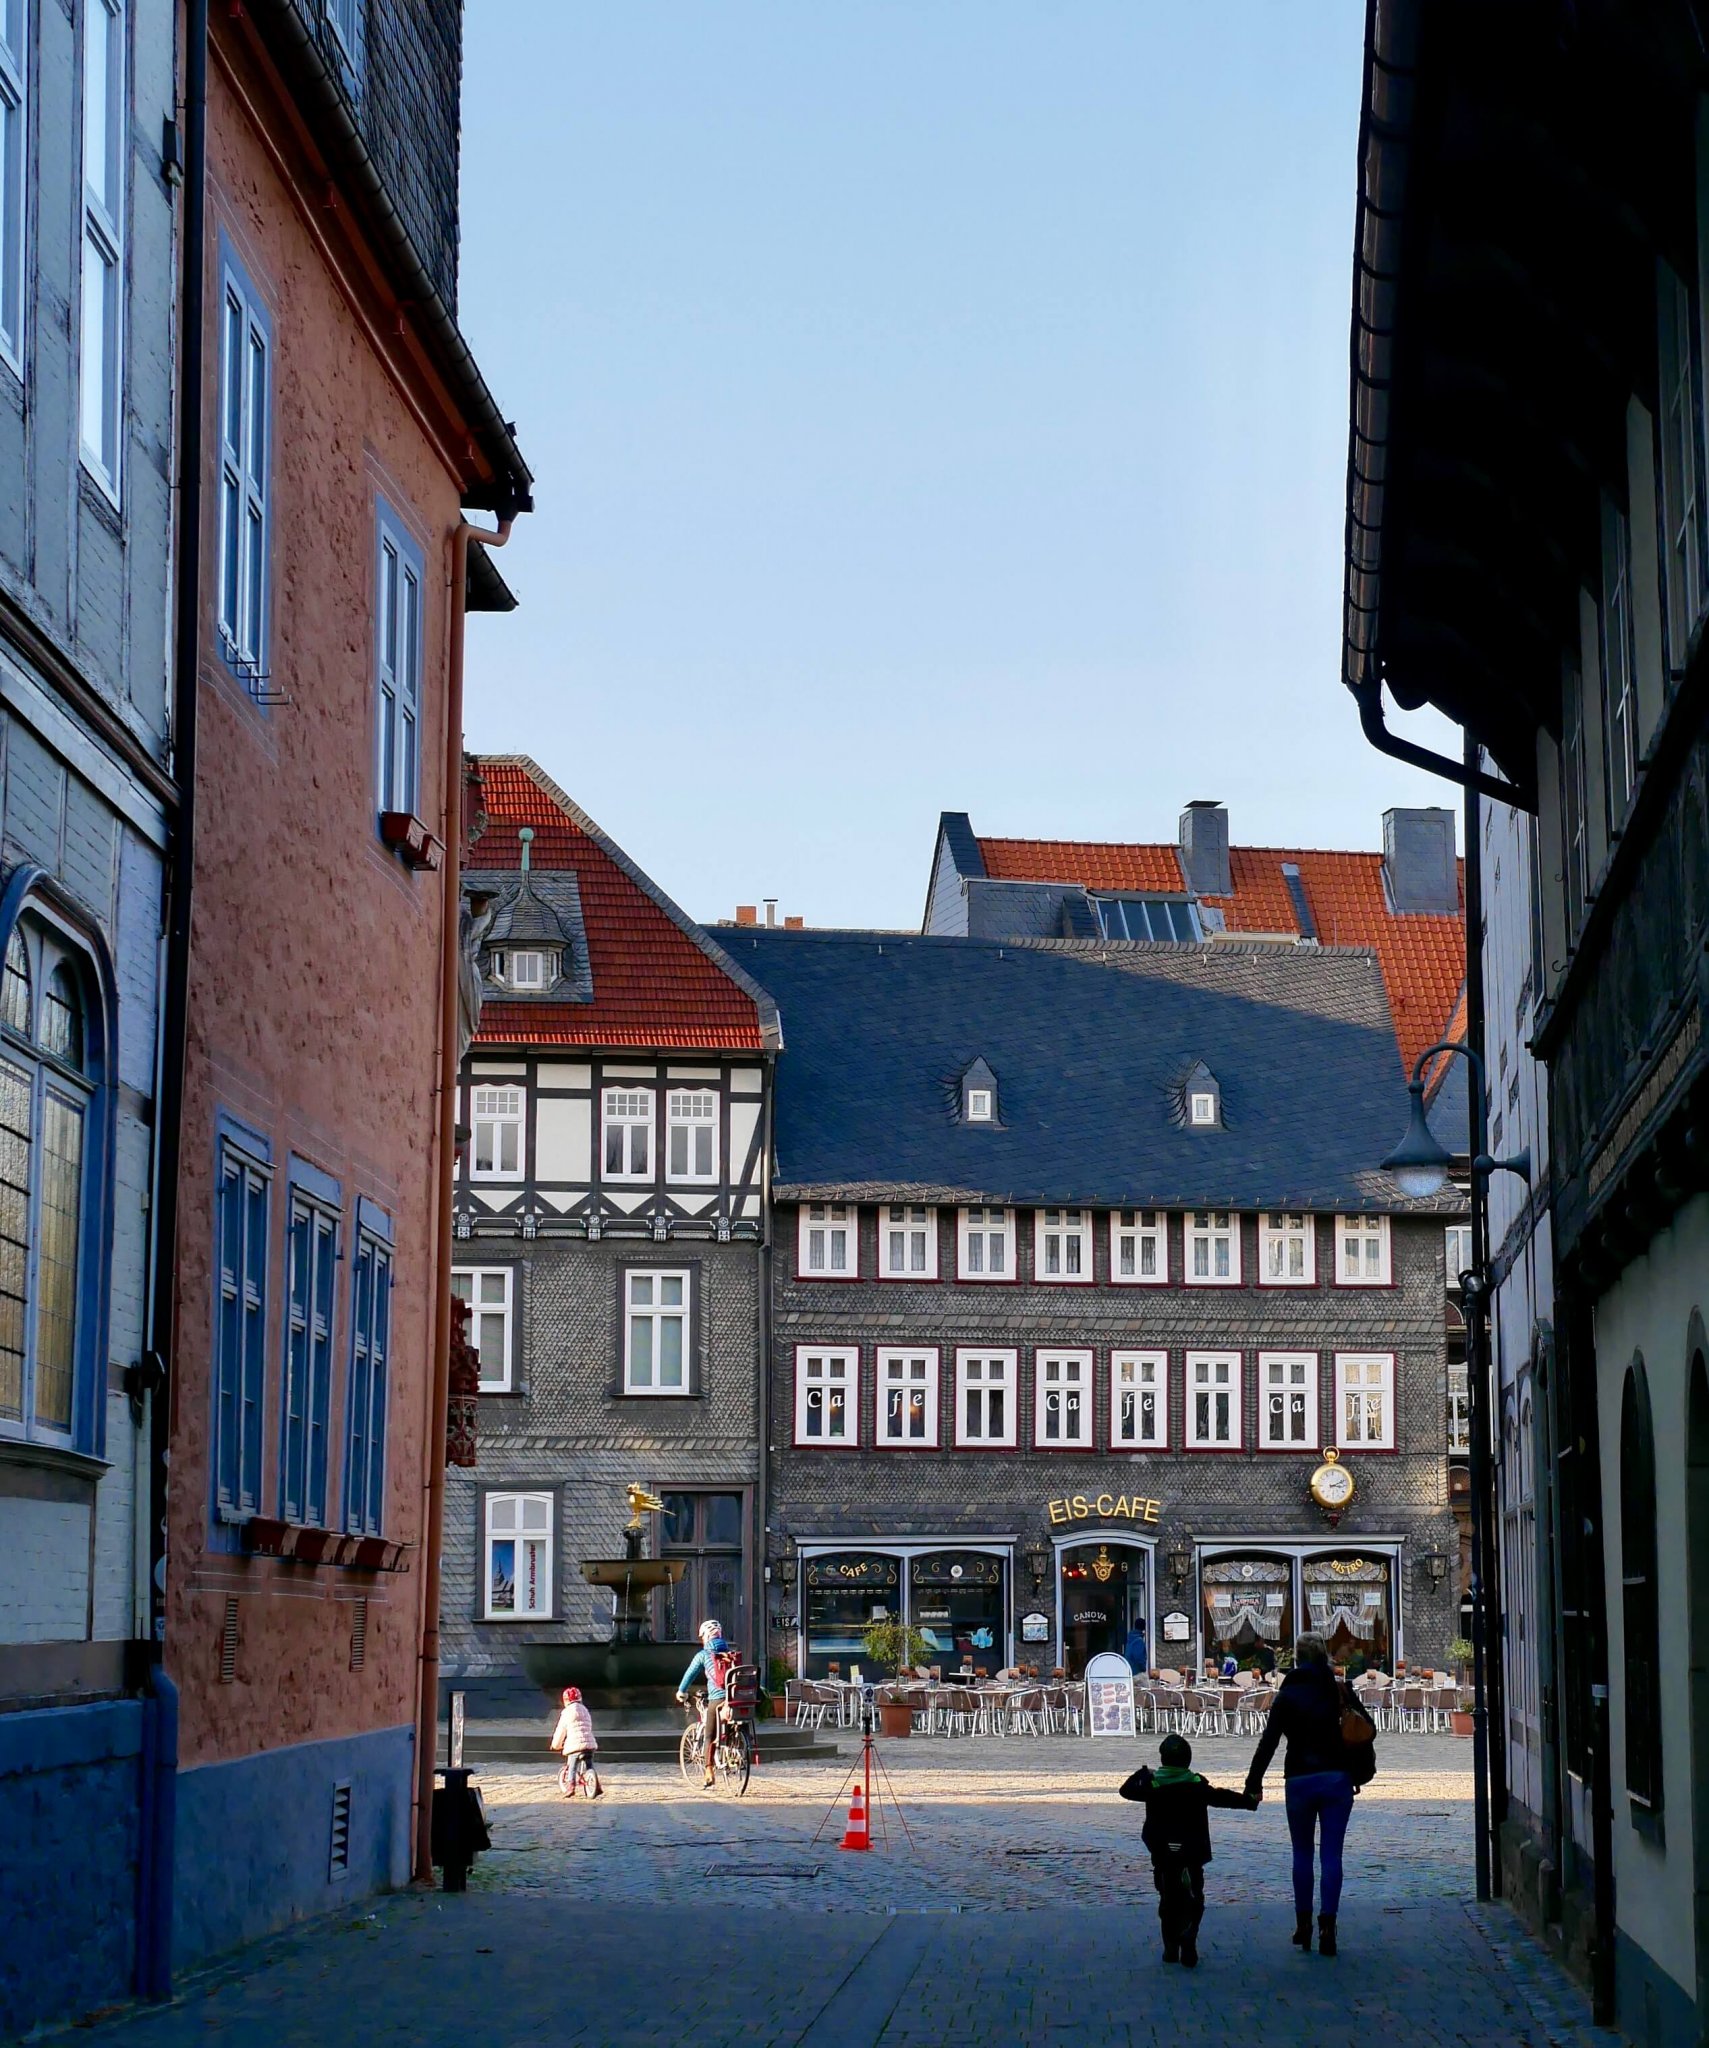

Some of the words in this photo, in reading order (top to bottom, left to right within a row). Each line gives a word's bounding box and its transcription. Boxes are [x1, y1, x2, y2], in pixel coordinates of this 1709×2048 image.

[1048, 1494, 1160, 1524] EIS-CAFE
[839, 1562, 868, 1578] CAFE
[1331, 1558, 1363, 1575] BISTRO
[776, 1617, 790, 1627] EIS
[1073, 1611, 1107, 1622] CANOVA
